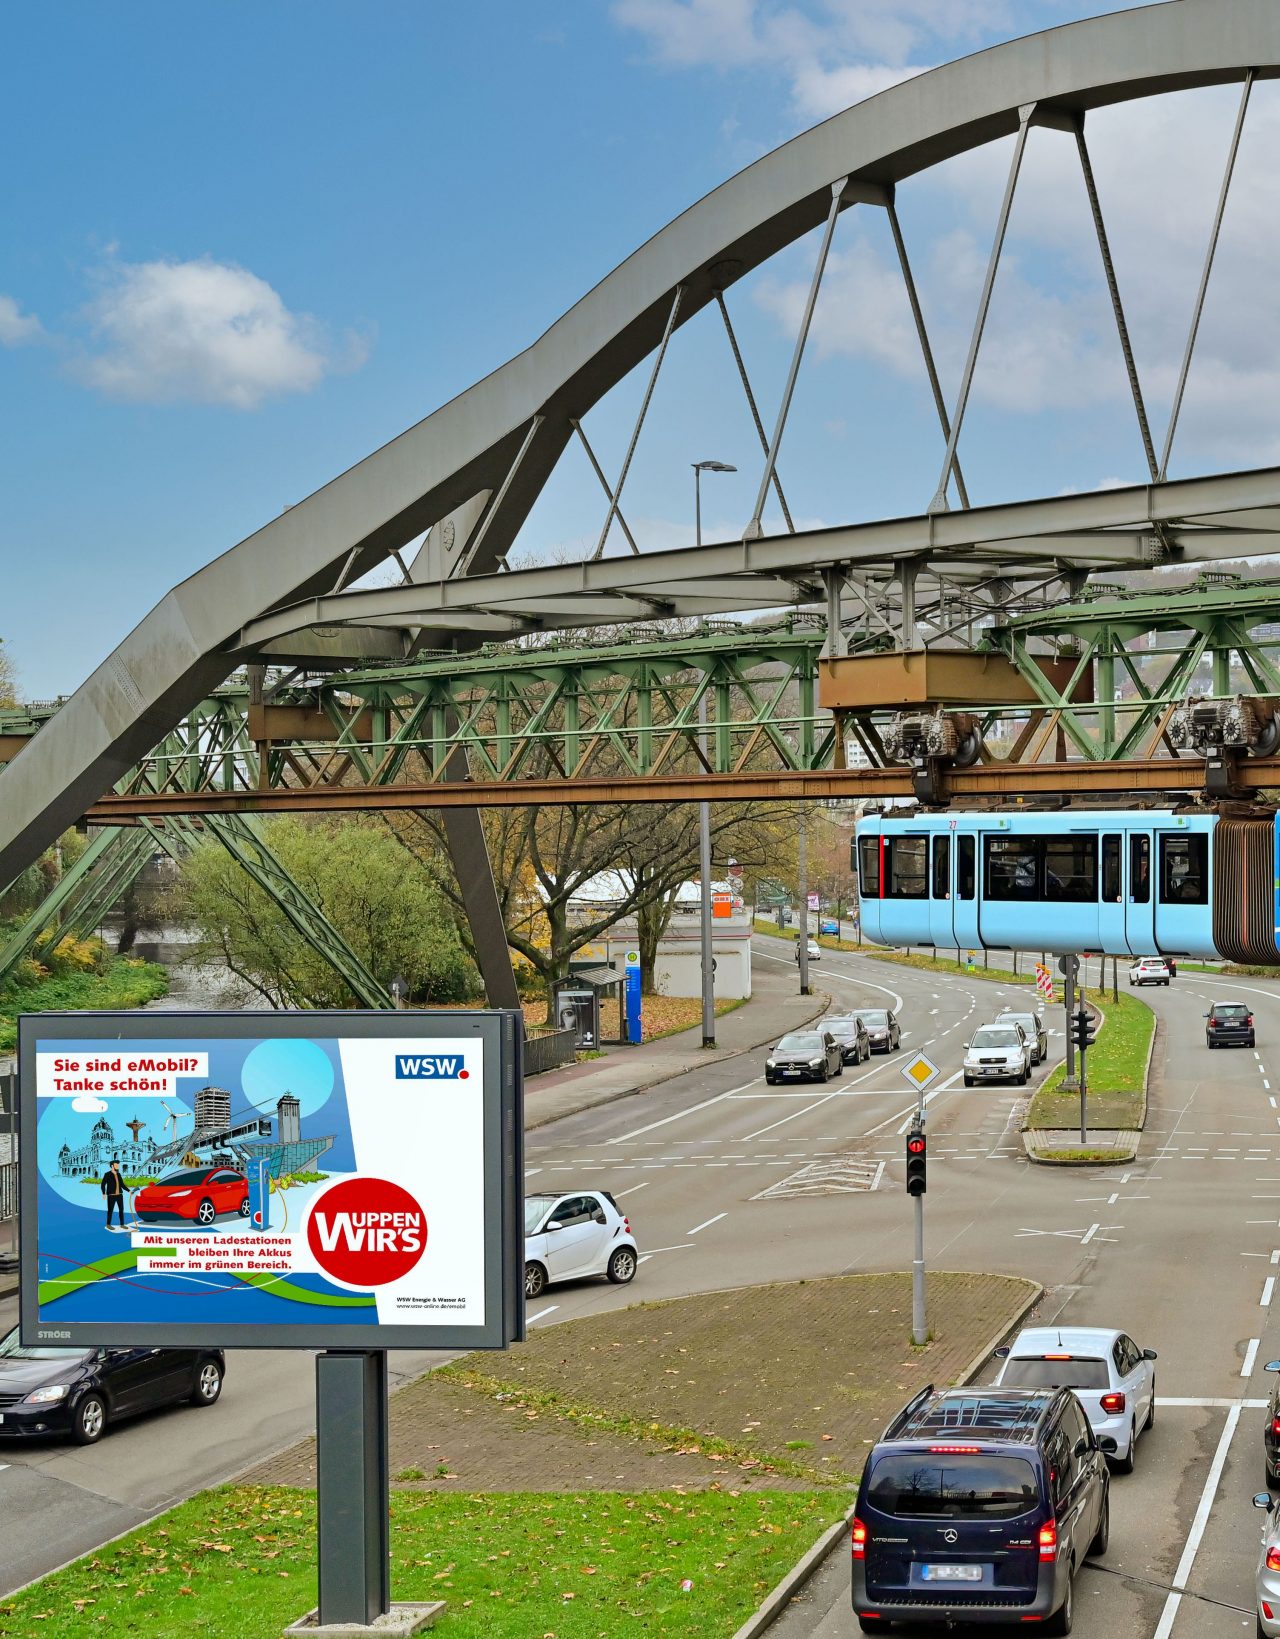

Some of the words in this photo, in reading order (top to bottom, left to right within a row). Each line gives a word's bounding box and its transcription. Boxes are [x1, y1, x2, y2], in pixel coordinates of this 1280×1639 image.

[949, 821, 957, 829] 27
[54, 1058, 80, 1071] Sie
[86, 1058, 121, 1071] sind
[127, 1058, 198, 1071] eMobil?
[400, 1058, 457, 1076] WSW
[53, 1078, 104, 1091] Tanke
[110, 1078, 167, 1091] schön!
[314, 1212, 420, 1236] WUPPEN
[143, 1235, 163, 1244] Mit
[166, 1235, 210, 1244] unseren
[213, 1235, 292, 1245] Ladestationen
[314, 1224, 421, 1252] WIR'S
[188, 1248, 230, 1257] bleiben
[233, 1248, 255, 1257] Ihre
[258, 1248, 292, 1257] Akkus
[150, 1260, 185, 1269] immer
[189, 1260, 202, 1269] im
[205, 1260, 244, 1270] grünen
[248, 1260, 292, 1269] Bereich.
[38, 1330, 71, 1338] STRÖER
